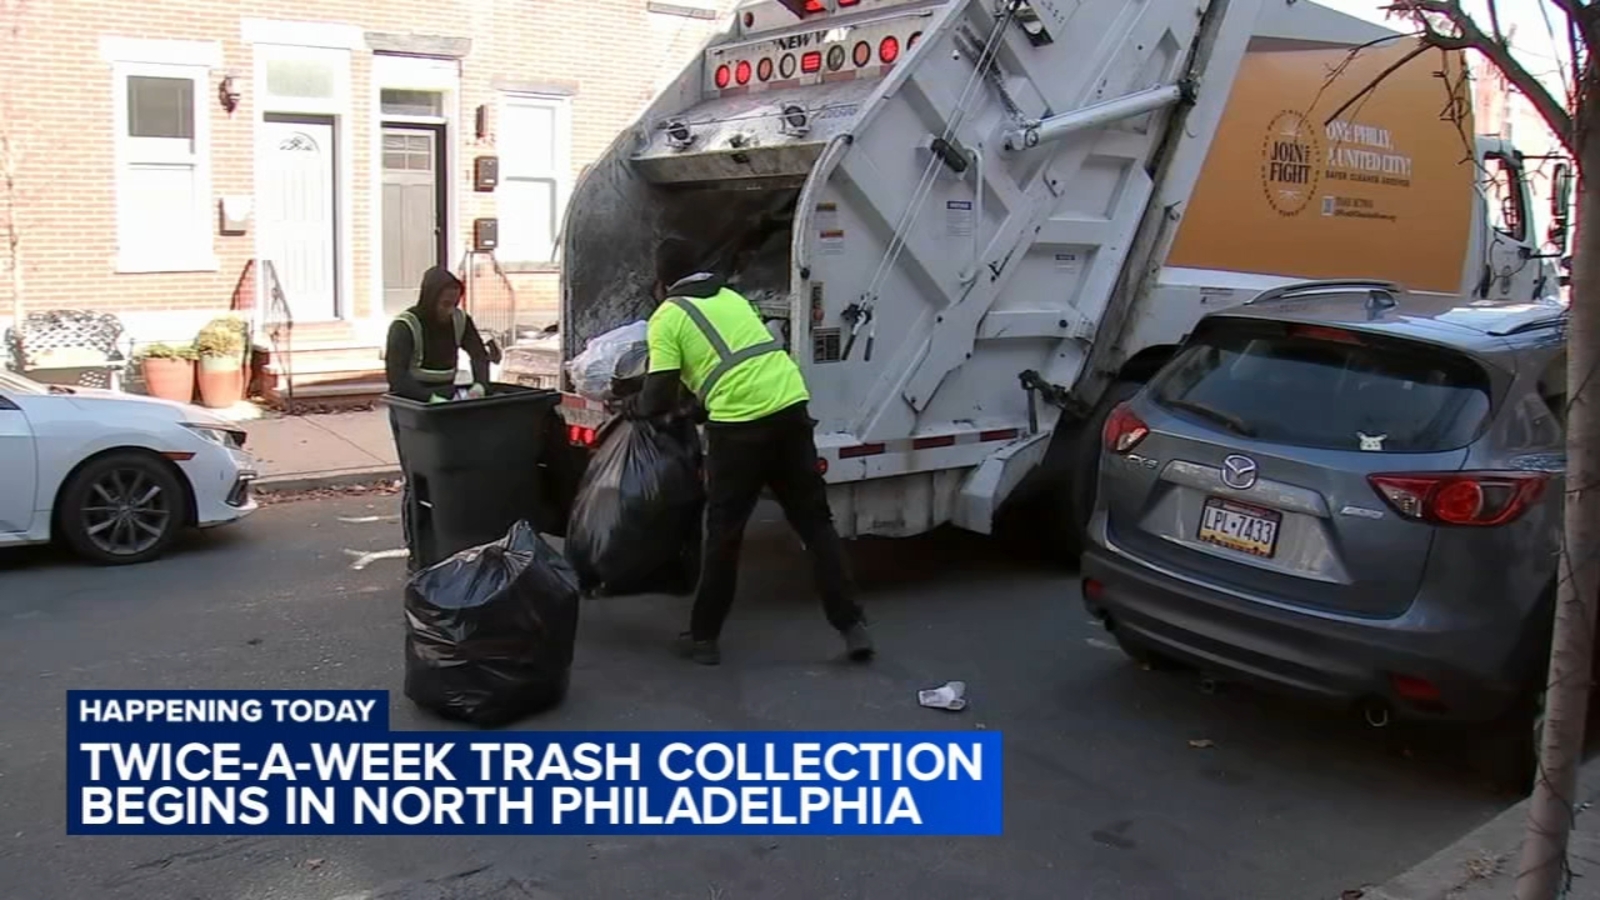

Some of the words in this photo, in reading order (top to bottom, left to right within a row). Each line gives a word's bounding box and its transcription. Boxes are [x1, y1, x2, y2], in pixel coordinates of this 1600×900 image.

[774, 32, 815, 51] NEW
[1270, 141, 1304, 163] JOIN
[1337, 148, 1381, 171] UNITED
[1269, 162, 1312, 185] FIGHT
